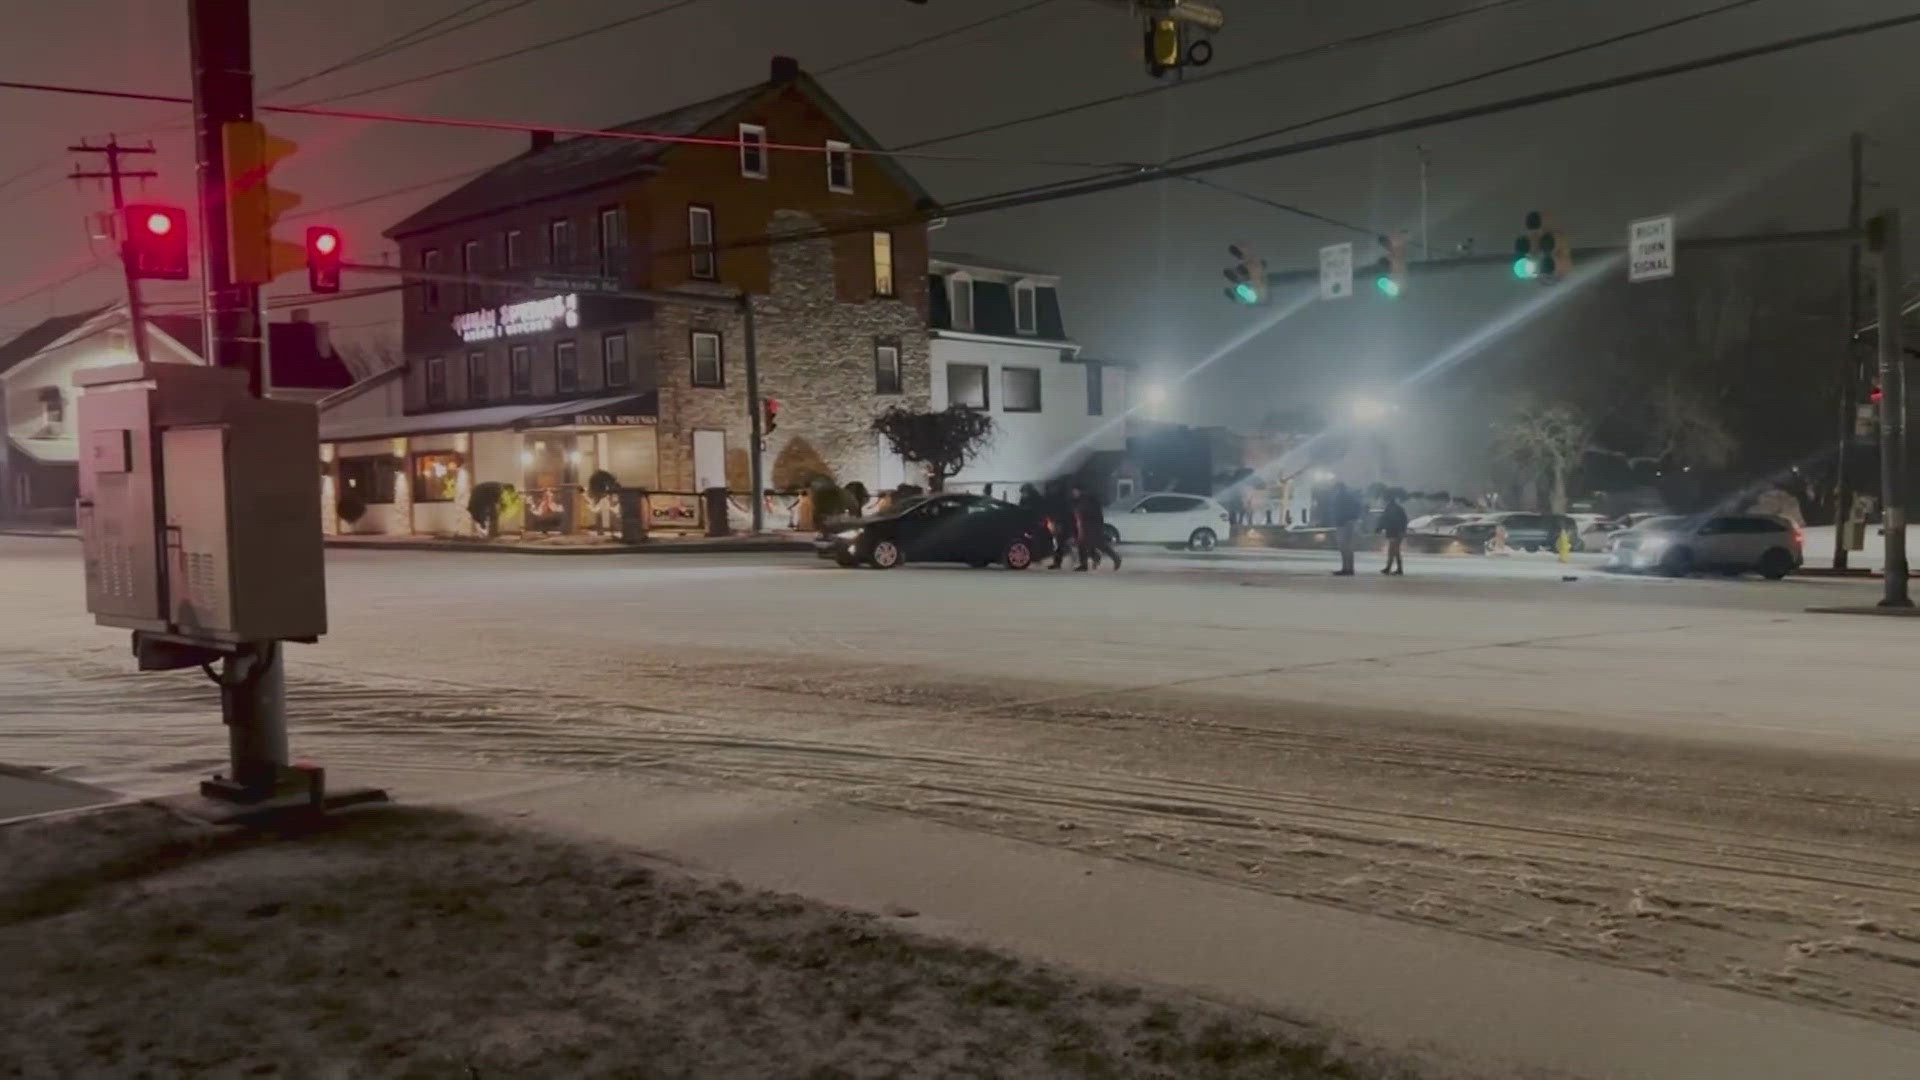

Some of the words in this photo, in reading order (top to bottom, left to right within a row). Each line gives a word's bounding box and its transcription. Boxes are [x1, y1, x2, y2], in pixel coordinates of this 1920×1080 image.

[1637, 223, 1665, 238] RIGHT
[1639, 242, 1665, 256] TURN
[1634, 258, 1669, 274] SIGNAL
